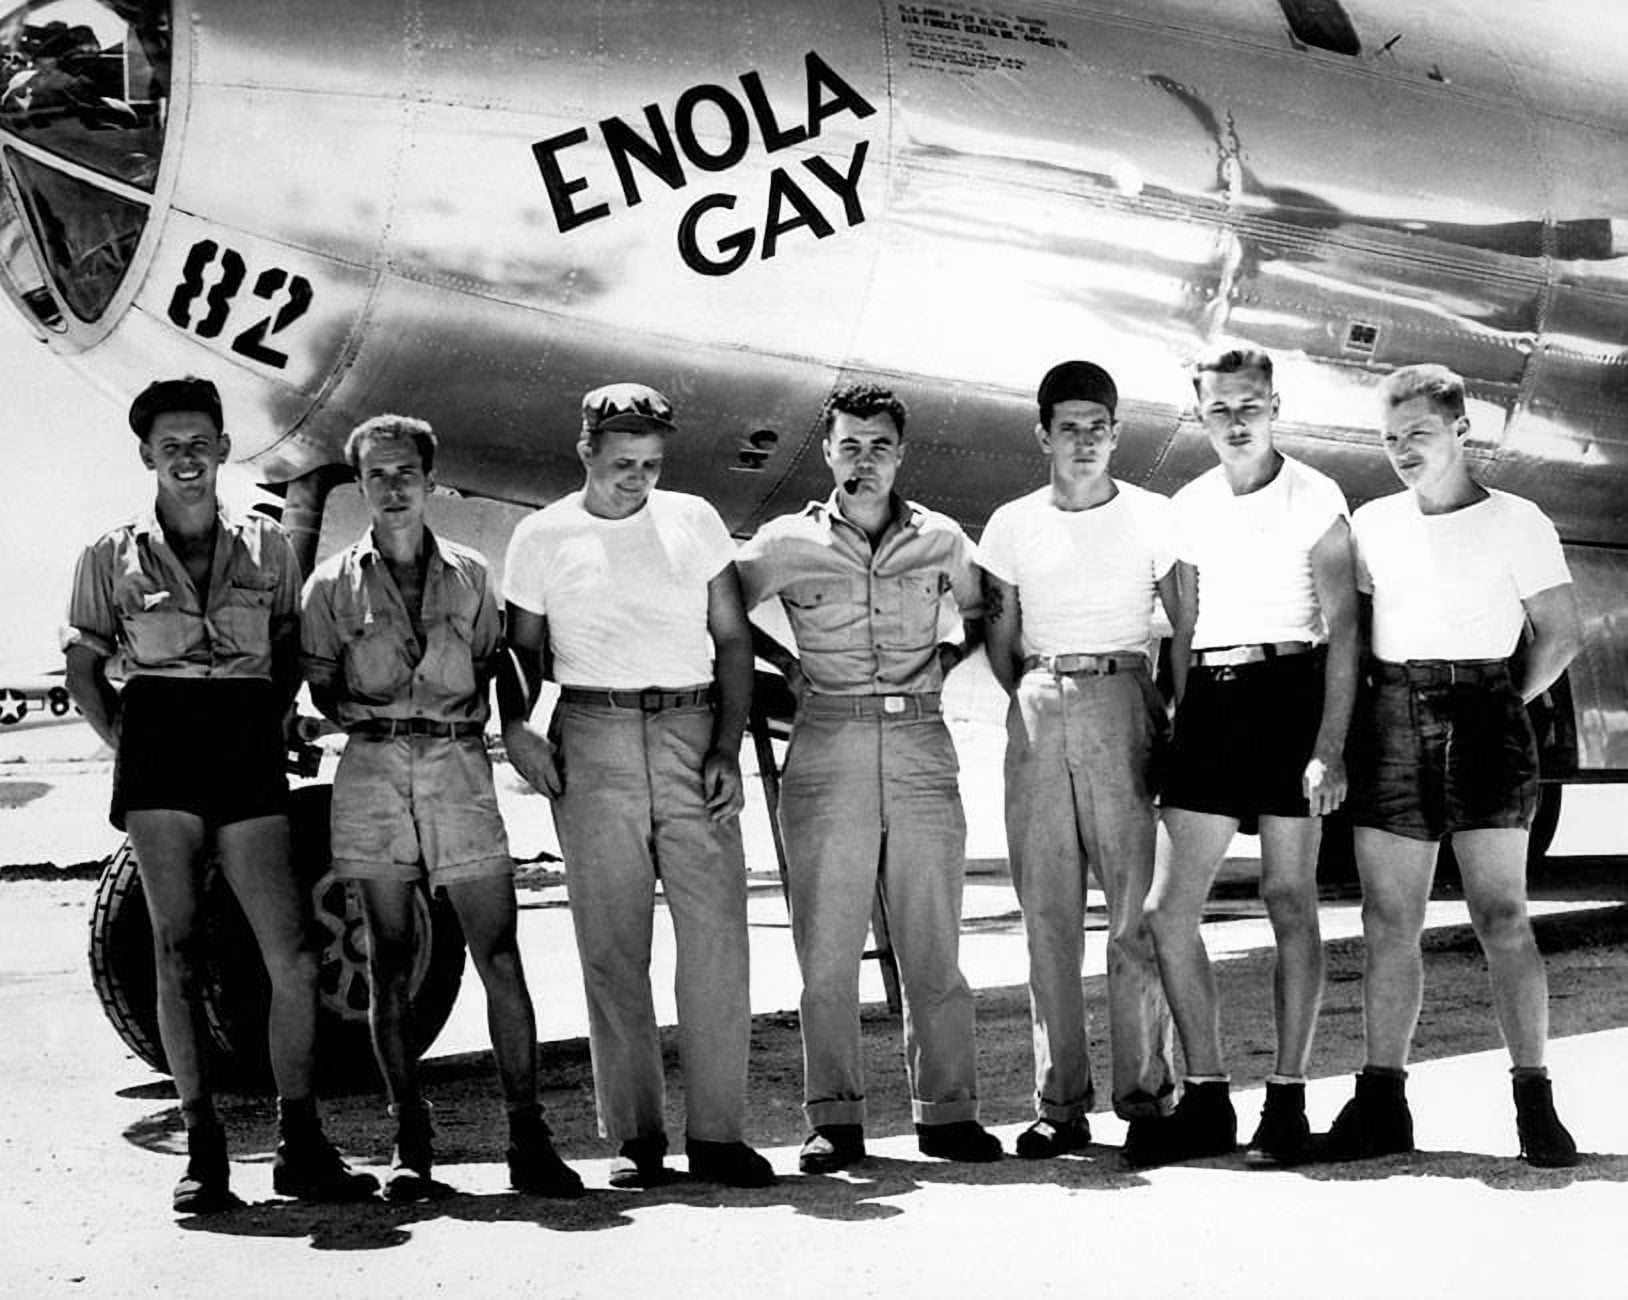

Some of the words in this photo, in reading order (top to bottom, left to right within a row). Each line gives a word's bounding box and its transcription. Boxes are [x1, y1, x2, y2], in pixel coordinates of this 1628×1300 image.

[532, 50, 877, 233] ENOLA
[677, 140, 869, 276] GAY
[168, 239, 313, 369] 82
